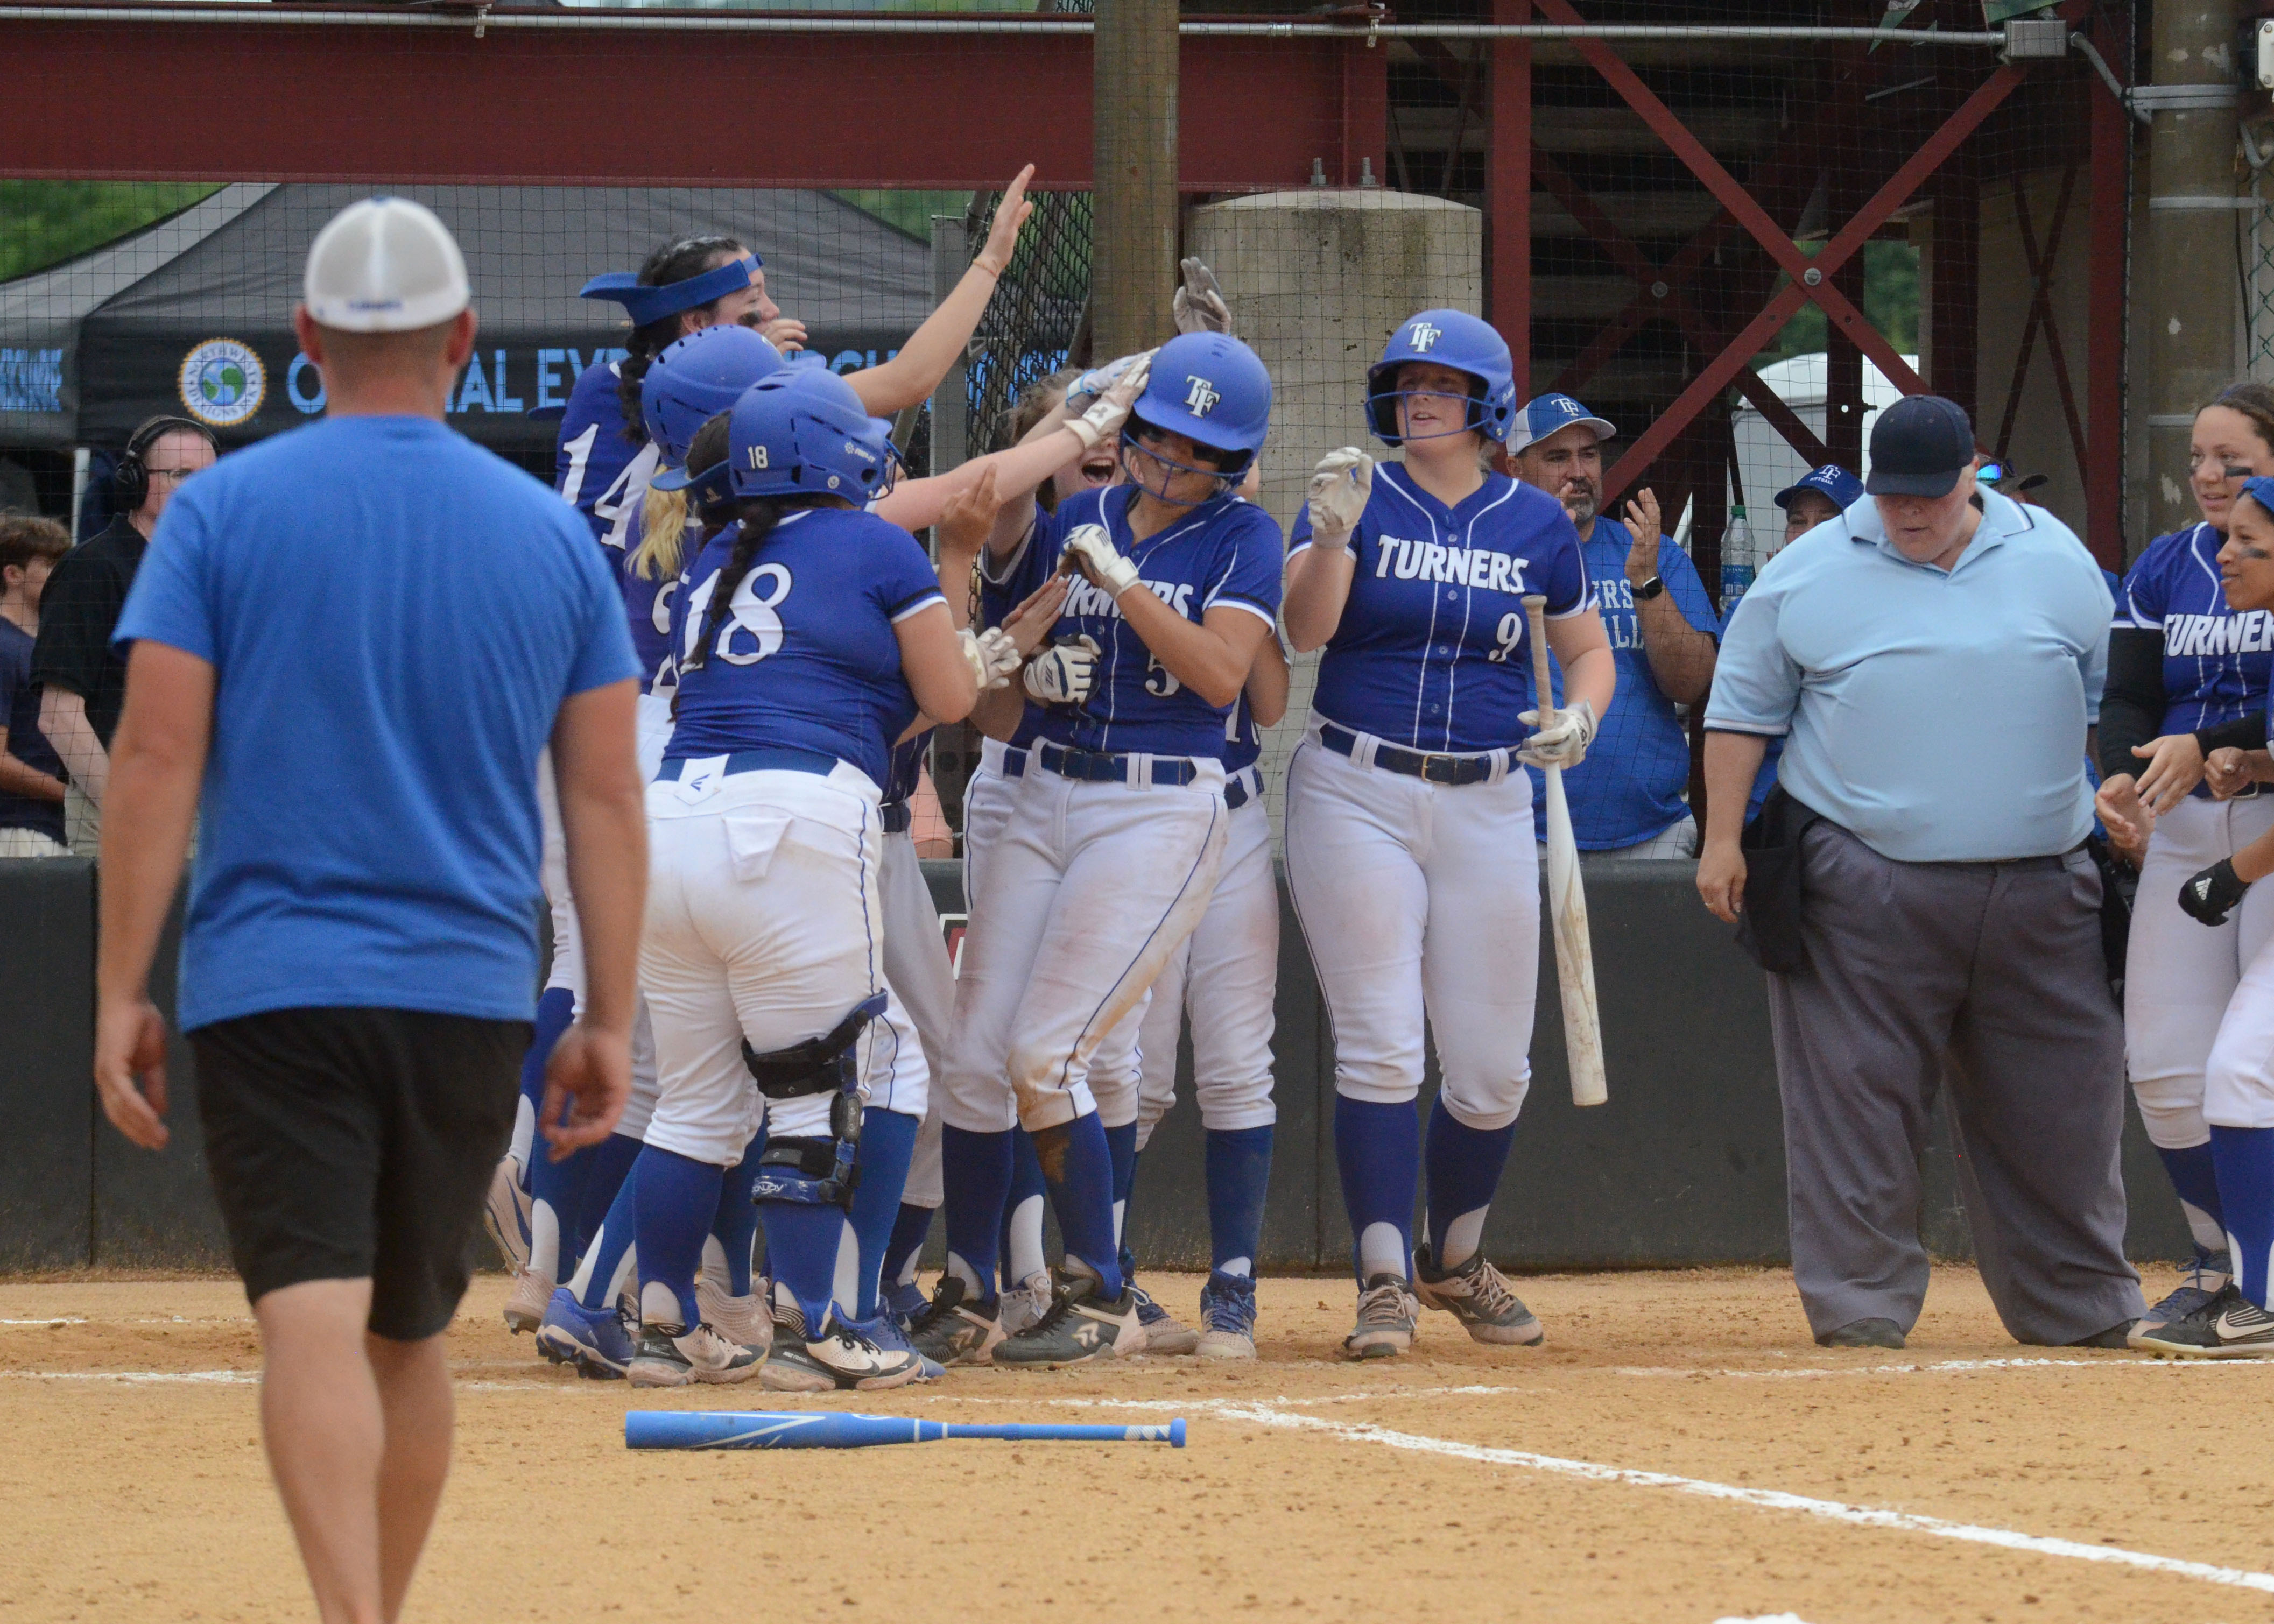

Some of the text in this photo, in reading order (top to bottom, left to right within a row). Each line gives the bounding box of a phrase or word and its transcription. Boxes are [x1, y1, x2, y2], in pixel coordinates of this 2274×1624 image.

[1409, 322, 1441, 354] TF
[1185, 375, 1220, 418] TF
[1551, 397, 1579, 416] TF
[748, 445, 769, 469] 18
[561, 423, 659, 550] 14
[1376, 535, 1529, 594] TURNERS
[680, 563, 792, 675] 18
[1489, 612, 1522, 662] 9
